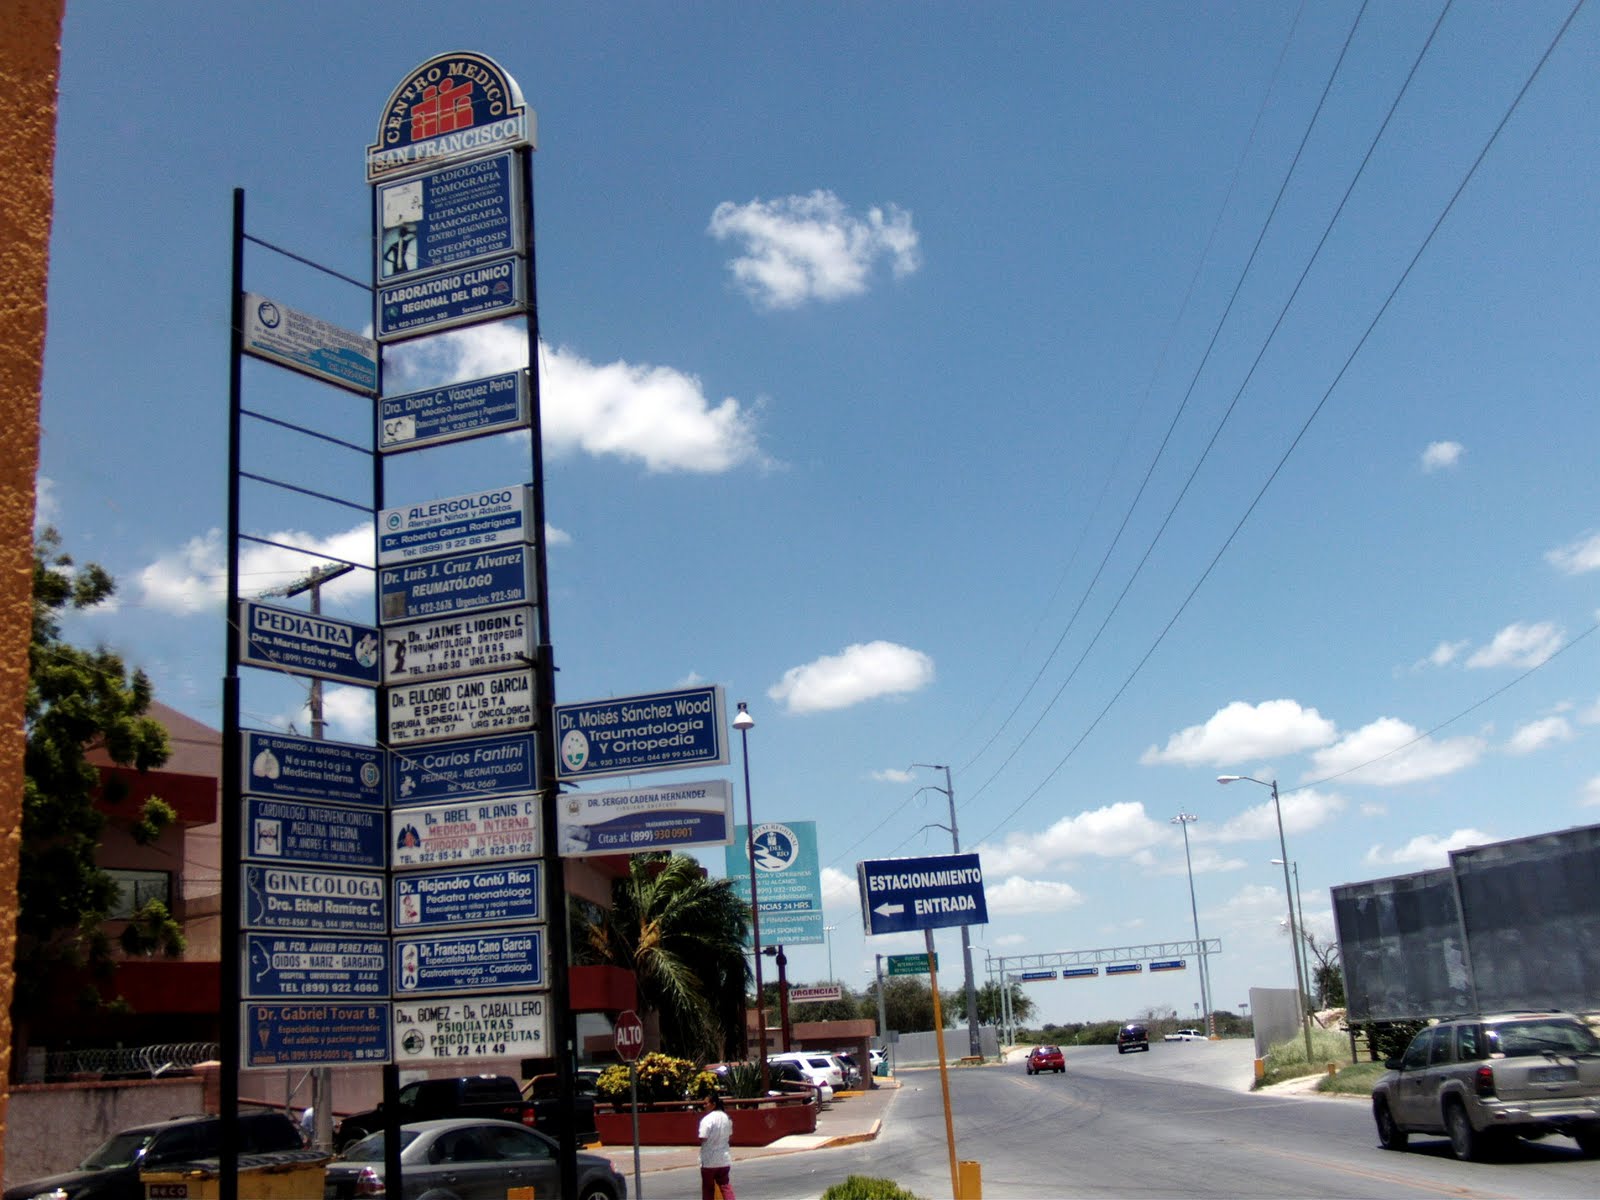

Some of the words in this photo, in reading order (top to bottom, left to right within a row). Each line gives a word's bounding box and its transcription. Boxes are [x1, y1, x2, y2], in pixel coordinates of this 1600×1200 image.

[387, 67, 441, 143] CENTRO
[447, 63, 503, 115] MEDICO
[374, 149, 412, 171] SAN
[413, 118, 518, 160] FRANCISCO
[431, 160, 498, 184] RADIOLOGIA
[430, 171, 501, 196] TOMOGRAFIA
[428, 196, 503, 221] ULTRASONIDO
[429, 208, 503, 232] MAMOGRAFIA
[427, 229, 456, 243] CENTRO
[428, 231, 507, 257] OSTEOPOROSIS
[385, 276, 461, 305] LABORATORIO
[464, 264, 509, 286] CLINICO
[402, 295, 448, 314] REGIONAL
[451, 290, 469, 302] DEL
[472, 285, 488, 298] RIO
[384, 403, 403, 415] Dra.
[405, 397, 433, 410] Diana
[435, 393, 445, 404] C.
[454, 399, 486, 410] Familiar
[409, 491, 512, 519] ALERGOLOGO
[408, 518, 441, 528] Alergias
[479, 504, 512, 516] Adultos
[385, 538, 399, 547] Dr.
[401, 529, 437, 543] Roberto
[439, 526, 466, 537] Garza
[419, 543, 442, 554] (899)
[446, 541, 450, 549] 9
[455, 539, 466, 547] 22
[469, 536, 481, 544] 86
[484, 534, 496, 542] 92
[384, 572, 399, 585] Dr.
[404, 569, 427, 581] Luis
[430, 567, 439, 576] J.
[443, 561, 471, 575] Cruz
[475, 553, 521, 569] Alvarez
[258, 611, 349, 644] PEDIATRA
[426, 624, 462, 640] JAIME
[252, 633, 272, 644] Dra.
[302, 642, 330, 655] Esther
[409, 637, 472, 654] TRAUMATOLOGIA
[478, 628, 523, 644] ORTOPEDIA
[428, 653, 433, 662] Y
[444, 643, 504, 660] FRACTURAS
[409, 687, 450, 706] EULOGIO
[457, 682, 485, 699] CANO
[491, 676, 528, 693] GARCIA
[414, 696, 506, 716] ESPECIALISTA
[560, 715, 575, 730] Dr.
[579, 708, 618, 727] Moisés
[622, 703, 672, 722] Sánchez
[675, 697, 710, 715] Wood
[391, 720, 421, 730] CIRUGIA
[426, 714, 464, 725] GENERAL
[479, 705, 530, 718] ONCOLOGICA
[589, 719, 704, 741] Traumatología
[272, 742, 308, 752] EDUARDO
[315, 748, 339, 756] NARRO
[613, 734, 695, 753] Ortopedia
[400, 758, 418, 772] Dr.
[424, 752, 470, 768] Carlos
[464, 763, 523, 777] NEONATOLOGO
[282, 767, 321, 779] Medicina
[323, 772, 354, 784] Interna
[478, 779, 496, 788] 9669
[588, 798, 600, 808] DR.
[602, 796, 628, 806] SERGIO
[630, 794, 659, 804] CADENA
[661, 790, 706, 801] HERNANDEZ
[259, 803, 306, 820] CARDIOLOGO
[308, 808, 372, 827] INTERVENCIONISTA
[444, 809, 471, 823] ABEL
[479, 804, 517, 819] ALANIS
[291, 822, 327, 837] MEDICINA
[329, 826, 359, 840] INTERNA
[429, 823, 476, 836] MEDICINA
[484, 817, 528, 831] INTERNA
[598, 834, 618, 844] Citas
[619, 832, 629, 843] al:
[630, 830, 653, 843] (899)
[654, 830, 670, 839] 930
[672, 828, 692, 838] 0901
[425, 839, 469, 851] CUIDADOS
[477, 831, 533, 847] INTENSIVOS
[268, 873, 380, 896] GINECOLOGA
[400, 882, 414, 894] Dr.
[418, 877, 470, 894] Alejandro
[473, 873, 504, 887] Cantú
[869, 868, 981, 891] ESTACIONAMIENTO
[268, 896, 292, 911] Dra.
[295, 898, 322, 912] Ethel
[325, 900, 368, 915] Ramírez
[370, 903, 380, 916] C.
[427, 894, 466, 903] Pediatra
[914, 895, 976, 915] ENTRADA
[274, 942, 287, 951] DR.
[290, 942, 307, 952] FCO.
[309, 943, 336, 952] JAVIER
[338, 943, 360, 953] PEREZ
[420, 945, 431, 957] Dr.
[434, 942, 476, 957] Francisco
[478, 940, 500, 953] Cano
[467, 953, 499, 962] Medicina
[274, 956, 300, 967] OIDOS
[310, 956, 333, 968] NARIZ
[342, 956, 382, 968] GARGANTA
[280, 984, 298, 992] TEL
[302, 983, 329, 994] (899)
[332, 984, 351, 992] 922
[791, 987, 839, 997] URGENCIAS
[258, 1008, 277, 1020] Dr.
[281, 1007, 327, 1020] Gabriel
[331, 1008, 364, 1019] Tovar
[368, 1008, 379, 1019] B.
[418, 1006, 450, 1023] GOMEZ
[481, 1001, 541, 1018] CABALLERO
[437, 1019, 514, 1032] PSIQUIATRAS
[431, 1030, 540, 1046] PSICOTERAPEUTAS
[617, 1026, 642, 1046] ALTO
[434, 1046, 451, 1056] TEL
[457, 1046, 469, 1055] 22
[476, 1045, 487, 1054] 41
[493, 1044, 506, 1054] 49
